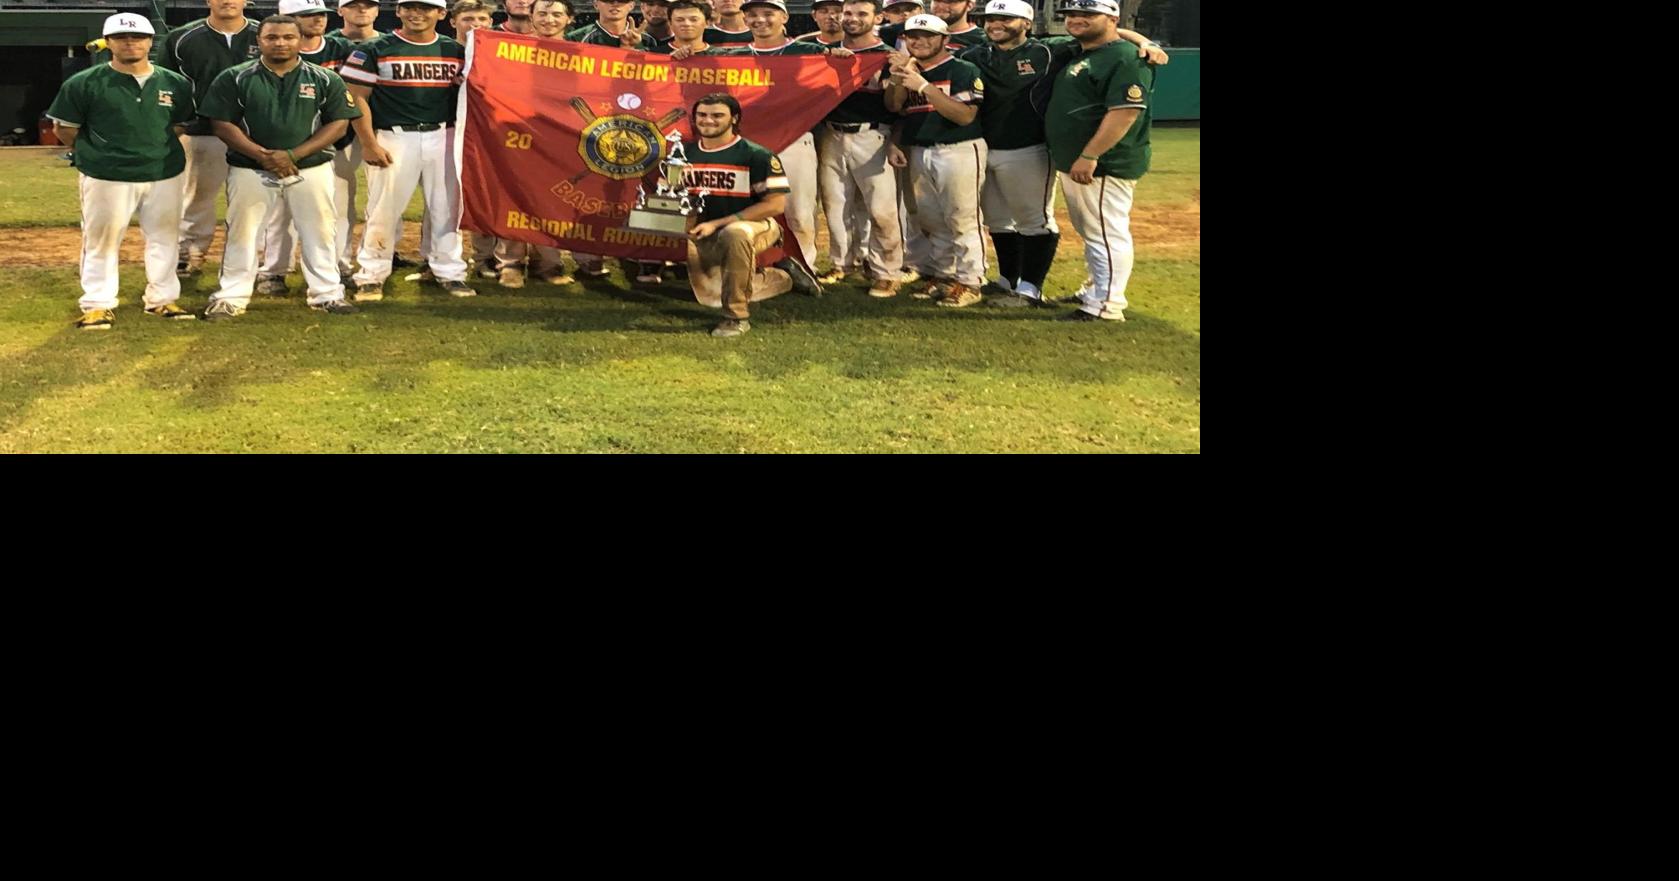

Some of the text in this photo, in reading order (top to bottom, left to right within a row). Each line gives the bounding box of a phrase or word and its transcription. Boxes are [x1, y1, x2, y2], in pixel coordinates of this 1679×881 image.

[120, 18, 137, 28] LR
[391, 63, 458, 81] RANGERS
[496, 41, 775, 86] AMERICAN LEGION BASEBALL
[504, 131, 533, 149] 20
[592, 119, 657, 144] AMERICAN
[683, 169, 737, 190] ANGERS
[550, 180, 634, 218] BASEB
[507, 210, 680, 249] REGIONAL RUNNER
